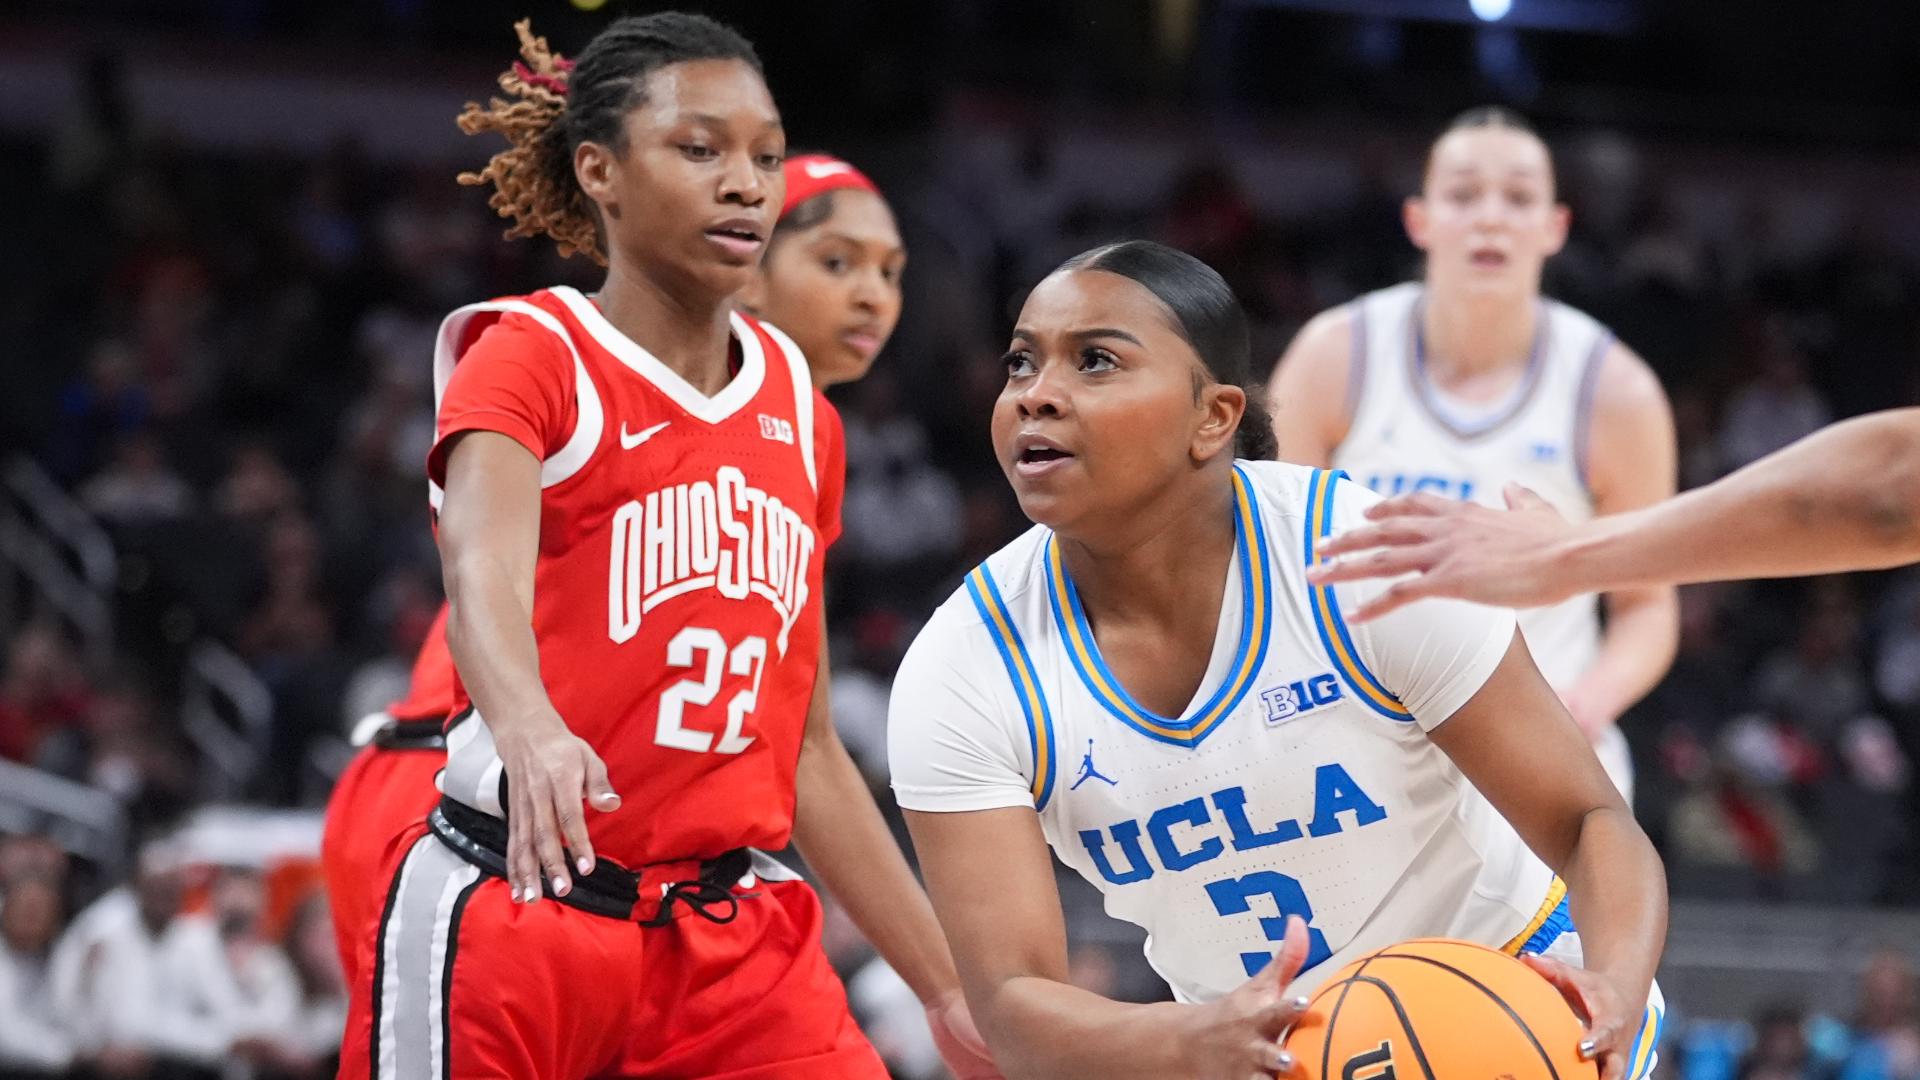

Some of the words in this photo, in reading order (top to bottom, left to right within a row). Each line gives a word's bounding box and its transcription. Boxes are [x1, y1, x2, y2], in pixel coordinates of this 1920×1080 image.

[654, 626, 768, 755] 22
[1077, 763, 1389, 886] UCLA
[1203, 870, 1334, 980] 3
